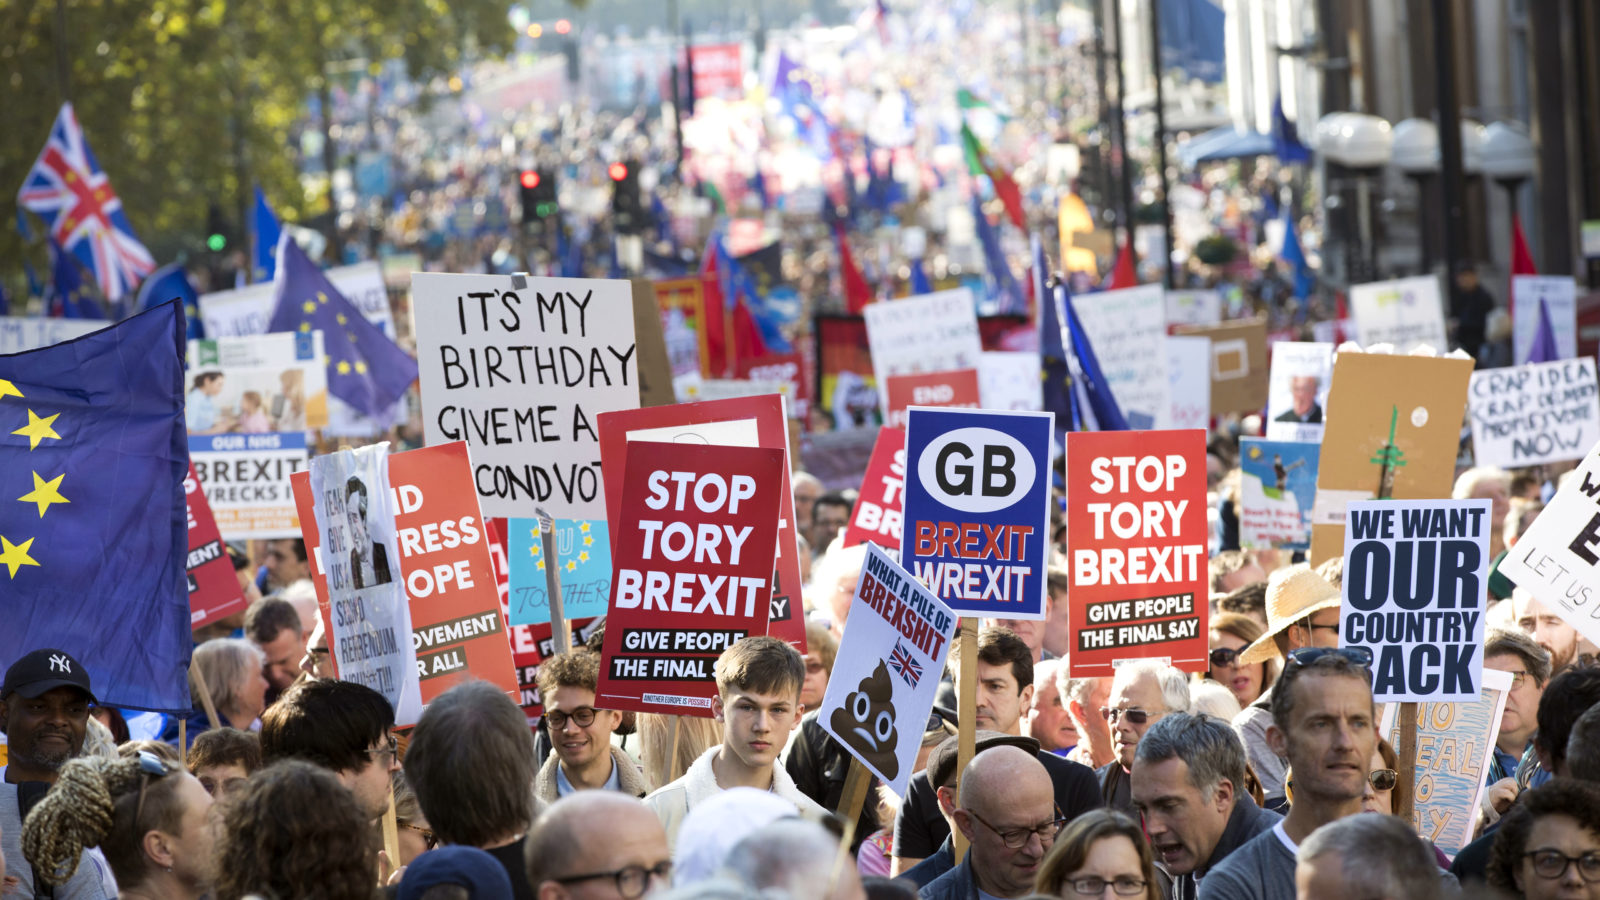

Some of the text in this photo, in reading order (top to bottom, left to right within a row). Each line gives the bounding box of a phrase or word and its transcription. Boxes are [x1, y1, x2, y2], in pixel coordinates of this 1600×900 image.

[457, 289, 593, 338] IT'S MY
[440, 343, 636, 390] BIRTHDAY
[1473, 363, 1590, 398] CRAP IDEA
[572, 403, 599, 442] A
[1473, 394, 1531, 421] CRAP
[212, 435, 281, 450] OUR NHS
[1513, 428, 1583, 459] NOW
[475, 463, 552, 503] COND
[935, 441, 1017, 498] GB
[1090, 454, 1188, 495] STOP
[644, 470, 757, 515] STOP
[1087, 499, 1190, 541] TORY
[1351, 507, 1486, 540] WE WANT
[638, 519, 755, 566] TORY
[914, 519, 1035, 562] BREXIT
[914, 560, 1032, 603] WREXIT
[1074, 544, 1204, 587] BREXIT
[1347, 540, 1482, 611] OUR
[1523, 547, 1593, 606] LET US
[615, 568, 766, 618] BREXIT
[867, 551, 951, 635] WHAT A PILE OF
[1088, 595, 1192, 622] GIVE PEOPLE
[412, 612, 498, 651] OVEMENT
[858, 571, 947, 663] BREXSHIT
[1081, 619, 1199, 649] THE FINAL SAY
[1345, 611, 1480, 644] COUNTRY
[432, 650, 464, 672] ALL
[625, 631, 745, 651] GIVE PEOPLE
[48, 653, 72, 674] NY
[614, 659, 648, 678] THE
[652, 659, 707, 678] FINAL
[682, 697, 688, 705] IS
[1416, 735, 1480, 777] EAL
